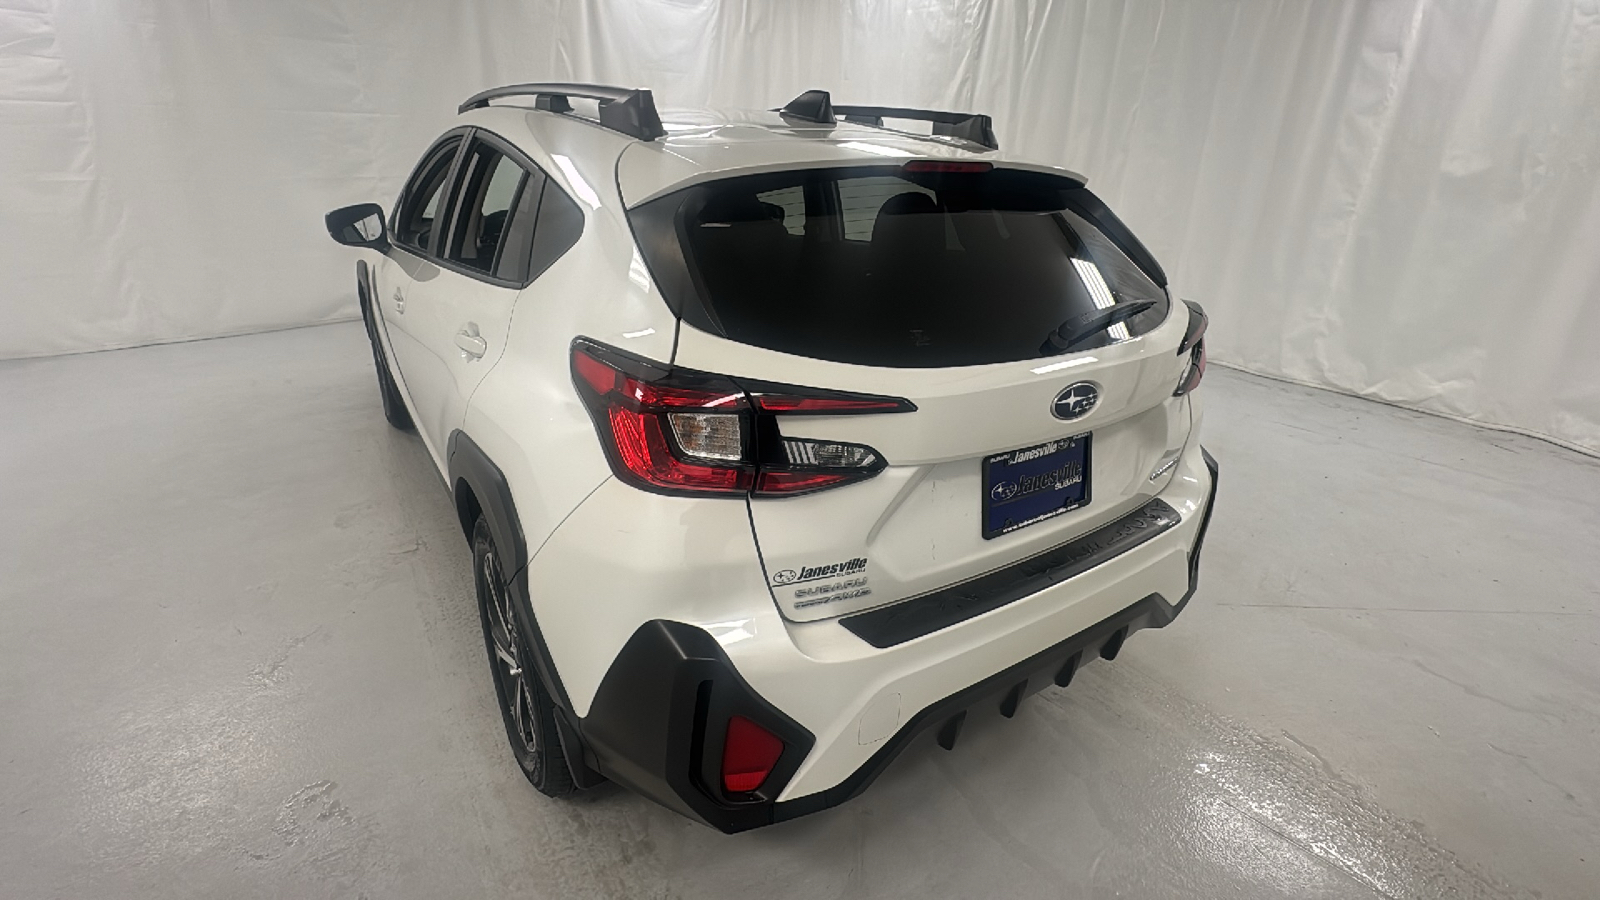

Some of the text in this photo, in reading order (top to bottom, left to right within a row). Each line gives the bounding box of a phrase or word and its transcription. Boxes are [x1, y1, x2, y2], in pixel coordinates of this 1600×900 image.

[1012, 441, 1058, 464] Janesville
[1017, 460, 1082, 496] Janesville
[1054, 475, 1082, 491] SUBARU
[797, 557, 868, 580] Janesville
[836, 568, 866, 578] SUBARU
[794, 576, 869, 598] SUBARU
